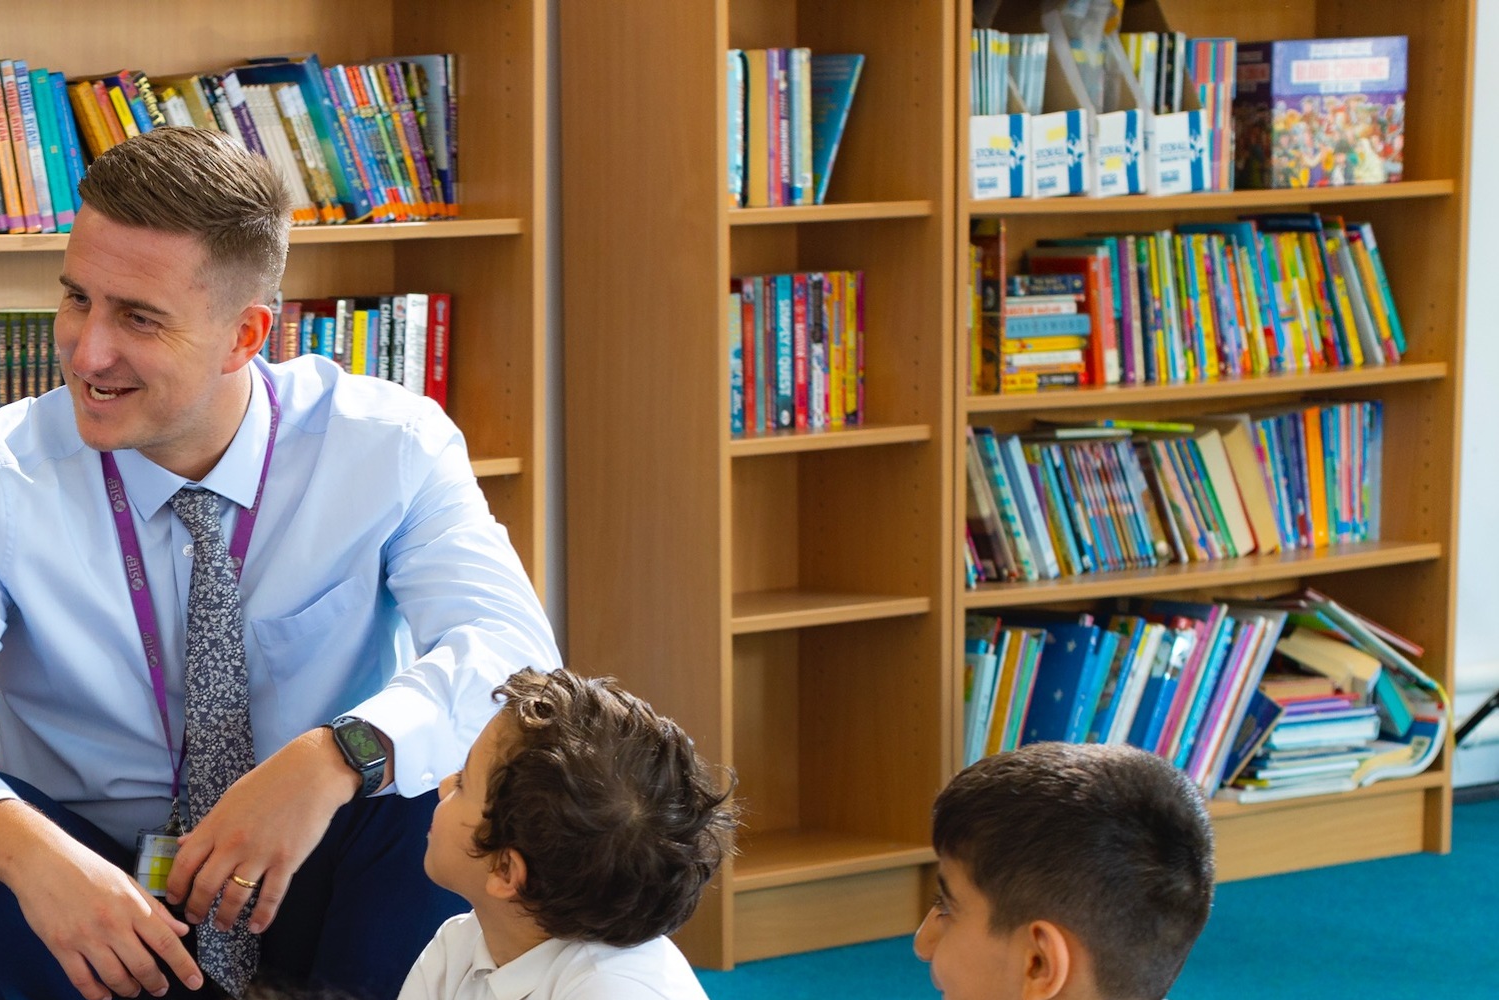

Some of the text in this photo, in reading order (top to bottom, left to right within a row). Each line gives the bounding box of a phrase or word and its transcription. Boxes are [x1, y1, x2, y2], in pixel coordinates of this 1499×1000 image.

[10, 116, 25, 142] RYAN
[24, 116, 39, 142] RYAN
[379, 303, 391, 345] CHASING
[777, 299, 791, 344] SIMPLY
[322, 321, 333, 352] DAISY
[778, 356, 792, 396] QUEST
[107, 478, 121, 501] STEP
[125, 555, 140, 579] STEP
[142, 632, 155, 656] STEP
